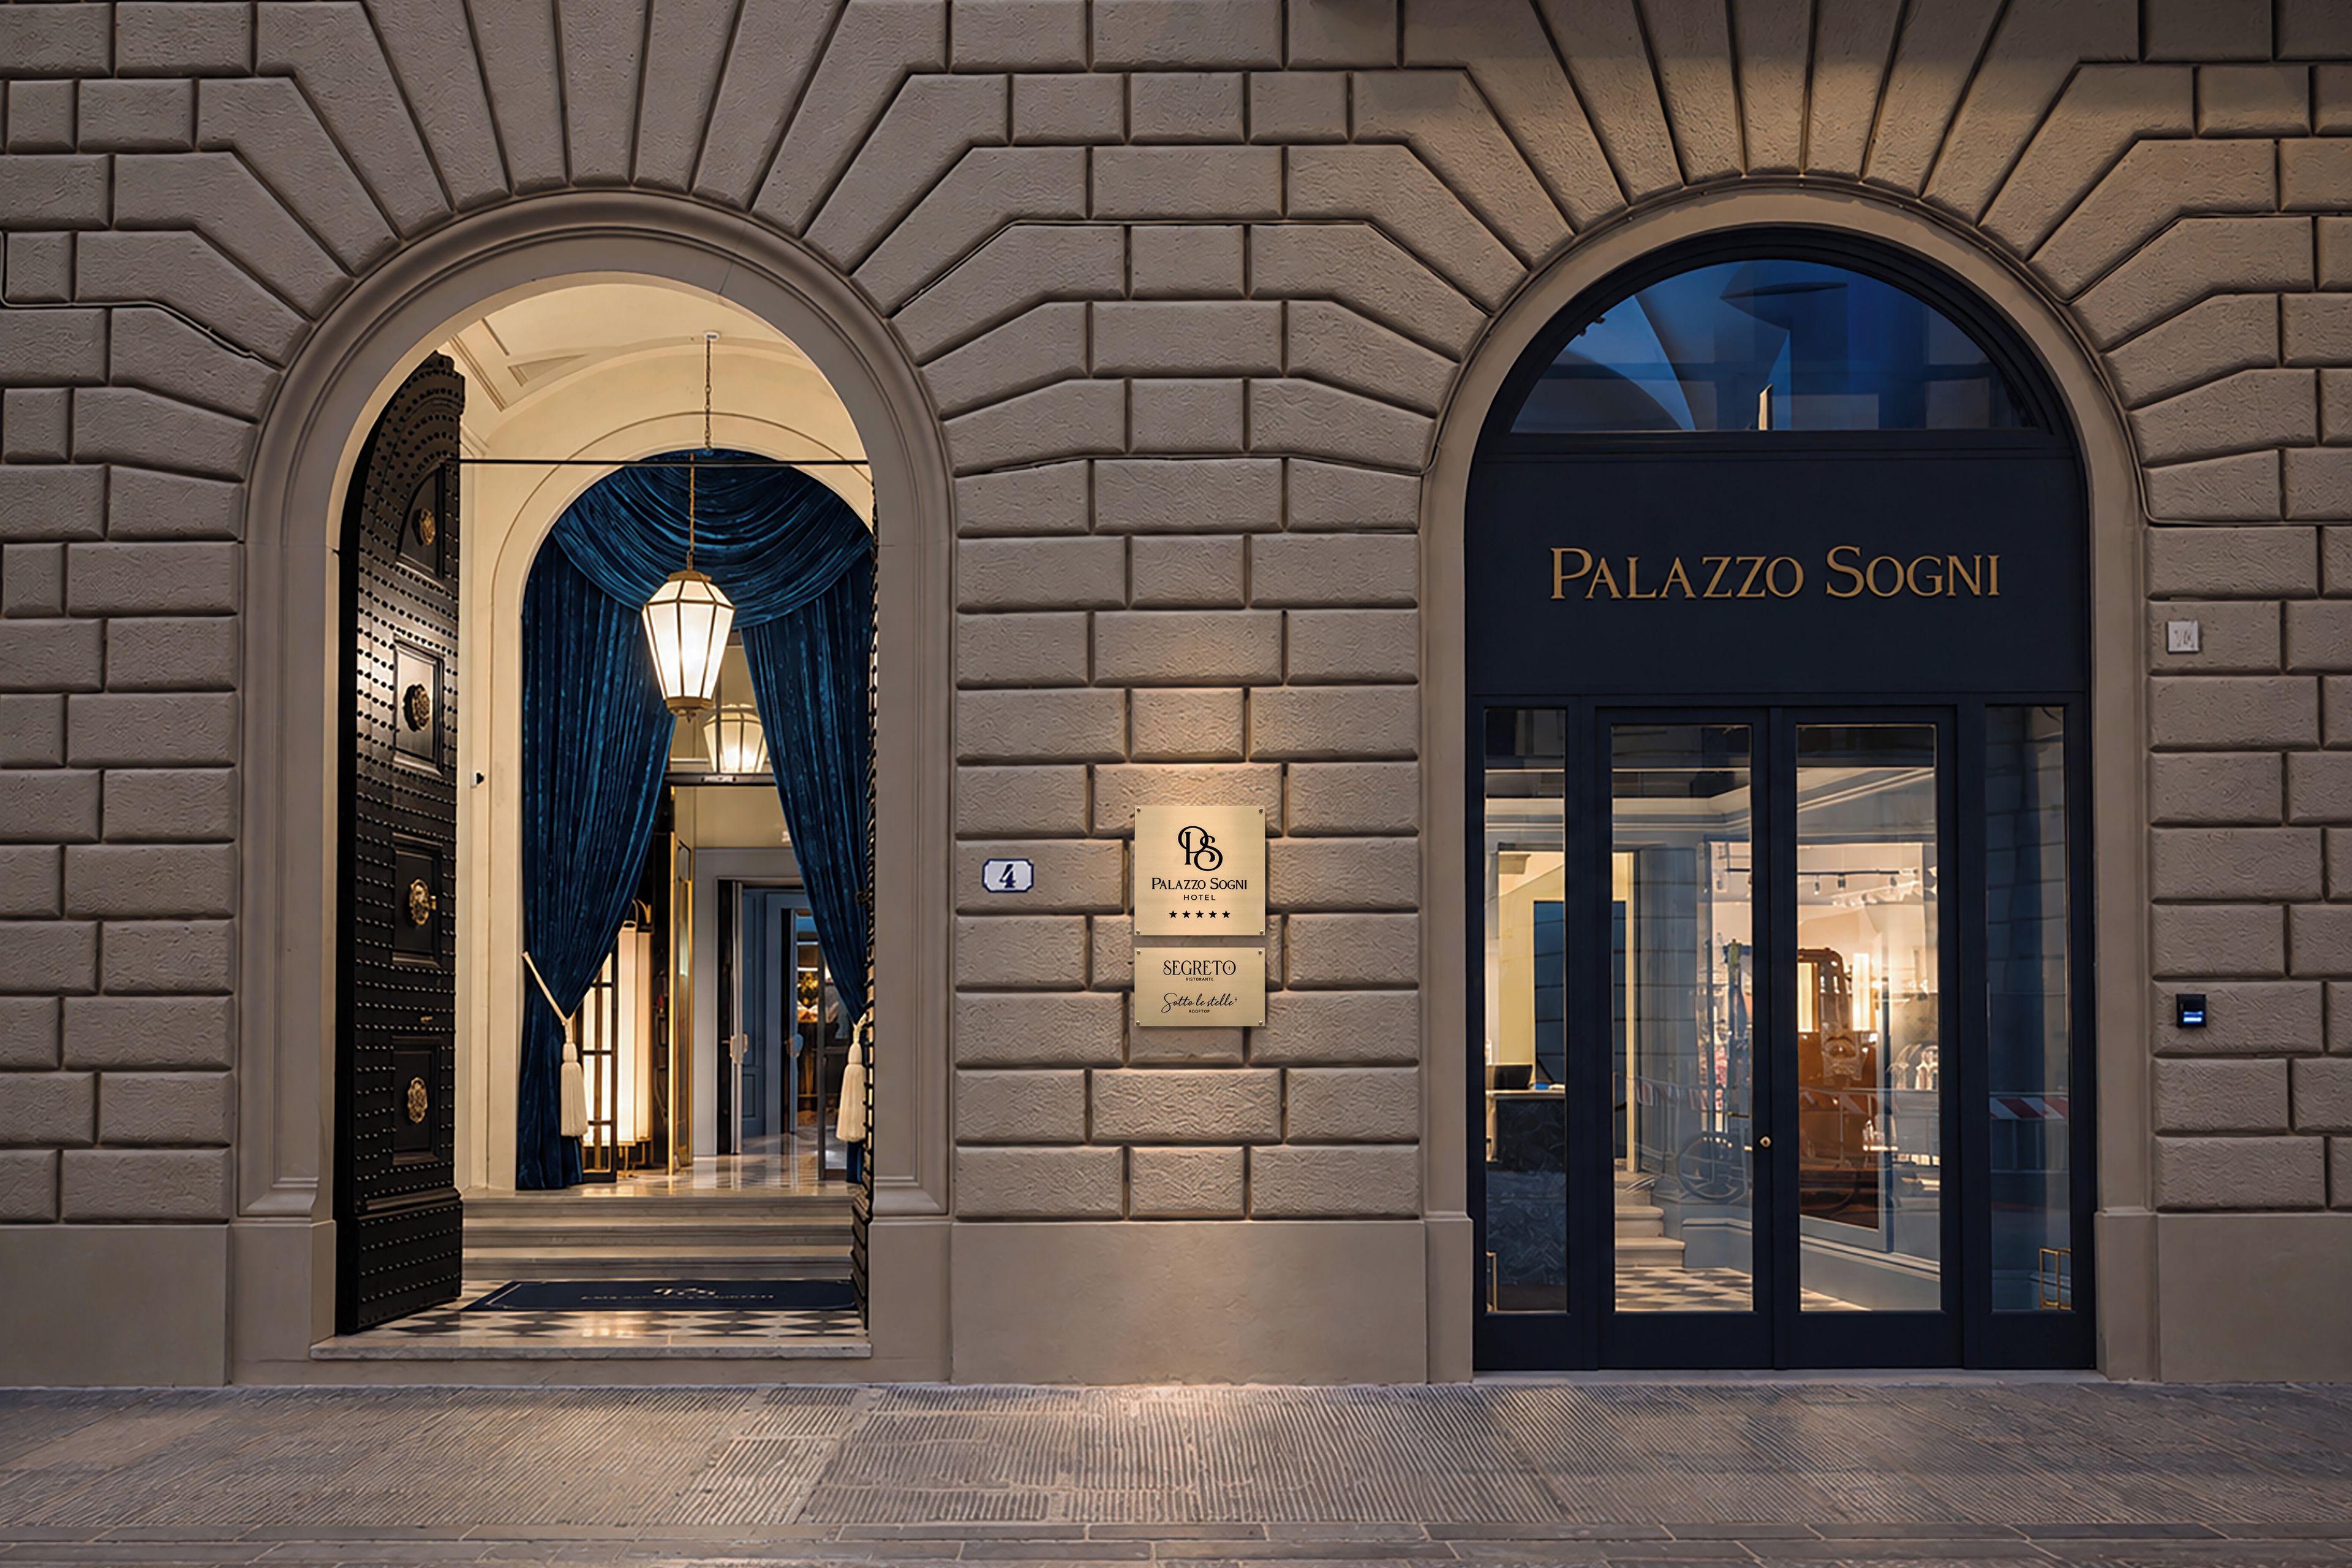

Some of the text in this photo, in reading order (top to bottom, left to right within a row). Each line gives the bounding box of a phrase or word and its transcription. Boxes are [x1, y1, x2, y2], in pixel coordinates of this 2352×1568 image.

[1550, 545, 2000, 599] PALAZZO SOGNI
[999, 864, 1016, 888] 4
[1152, 877, 1247, 890] PALAZZO SOGNI
[1163, 960, 1237, 976] SEGRETO
[1161, 992, 1235, 1014] Sotto le stelle
